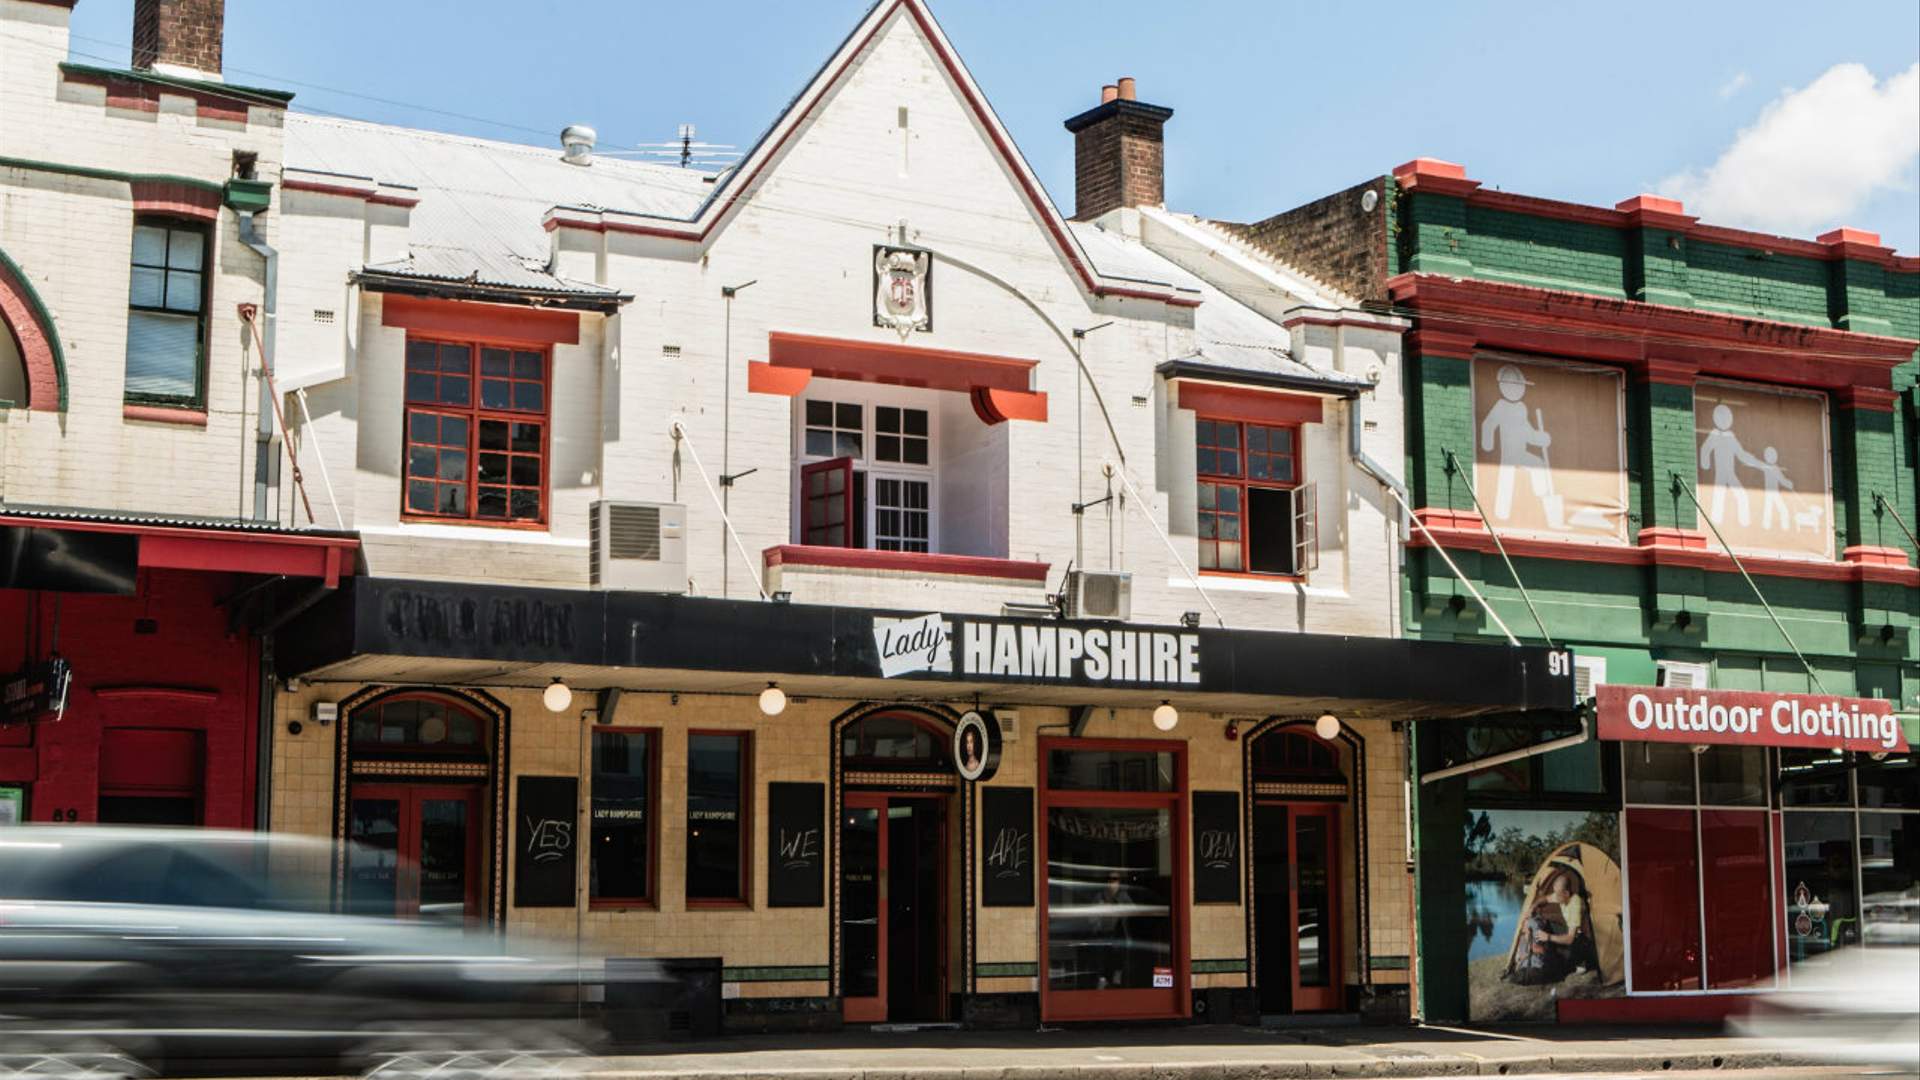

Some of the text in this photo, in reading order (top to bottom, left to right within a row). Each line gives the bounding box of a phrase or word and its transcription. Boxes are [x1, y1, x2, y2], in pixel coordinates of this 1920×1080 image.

[882, 618, 944, 665] Lady
[963, 621, 1201, 684] HAMPSHIRE
[1549, 651, 1569, 676] 91
[1628, 693, 1898, 748] Outdoor Clothing
[526, 816, 573, 853] YES
[780, 827, 819, 858] WE
[988, 828, 1029, 869] ARE
[1199, 829, 1237, 859] OPEN
